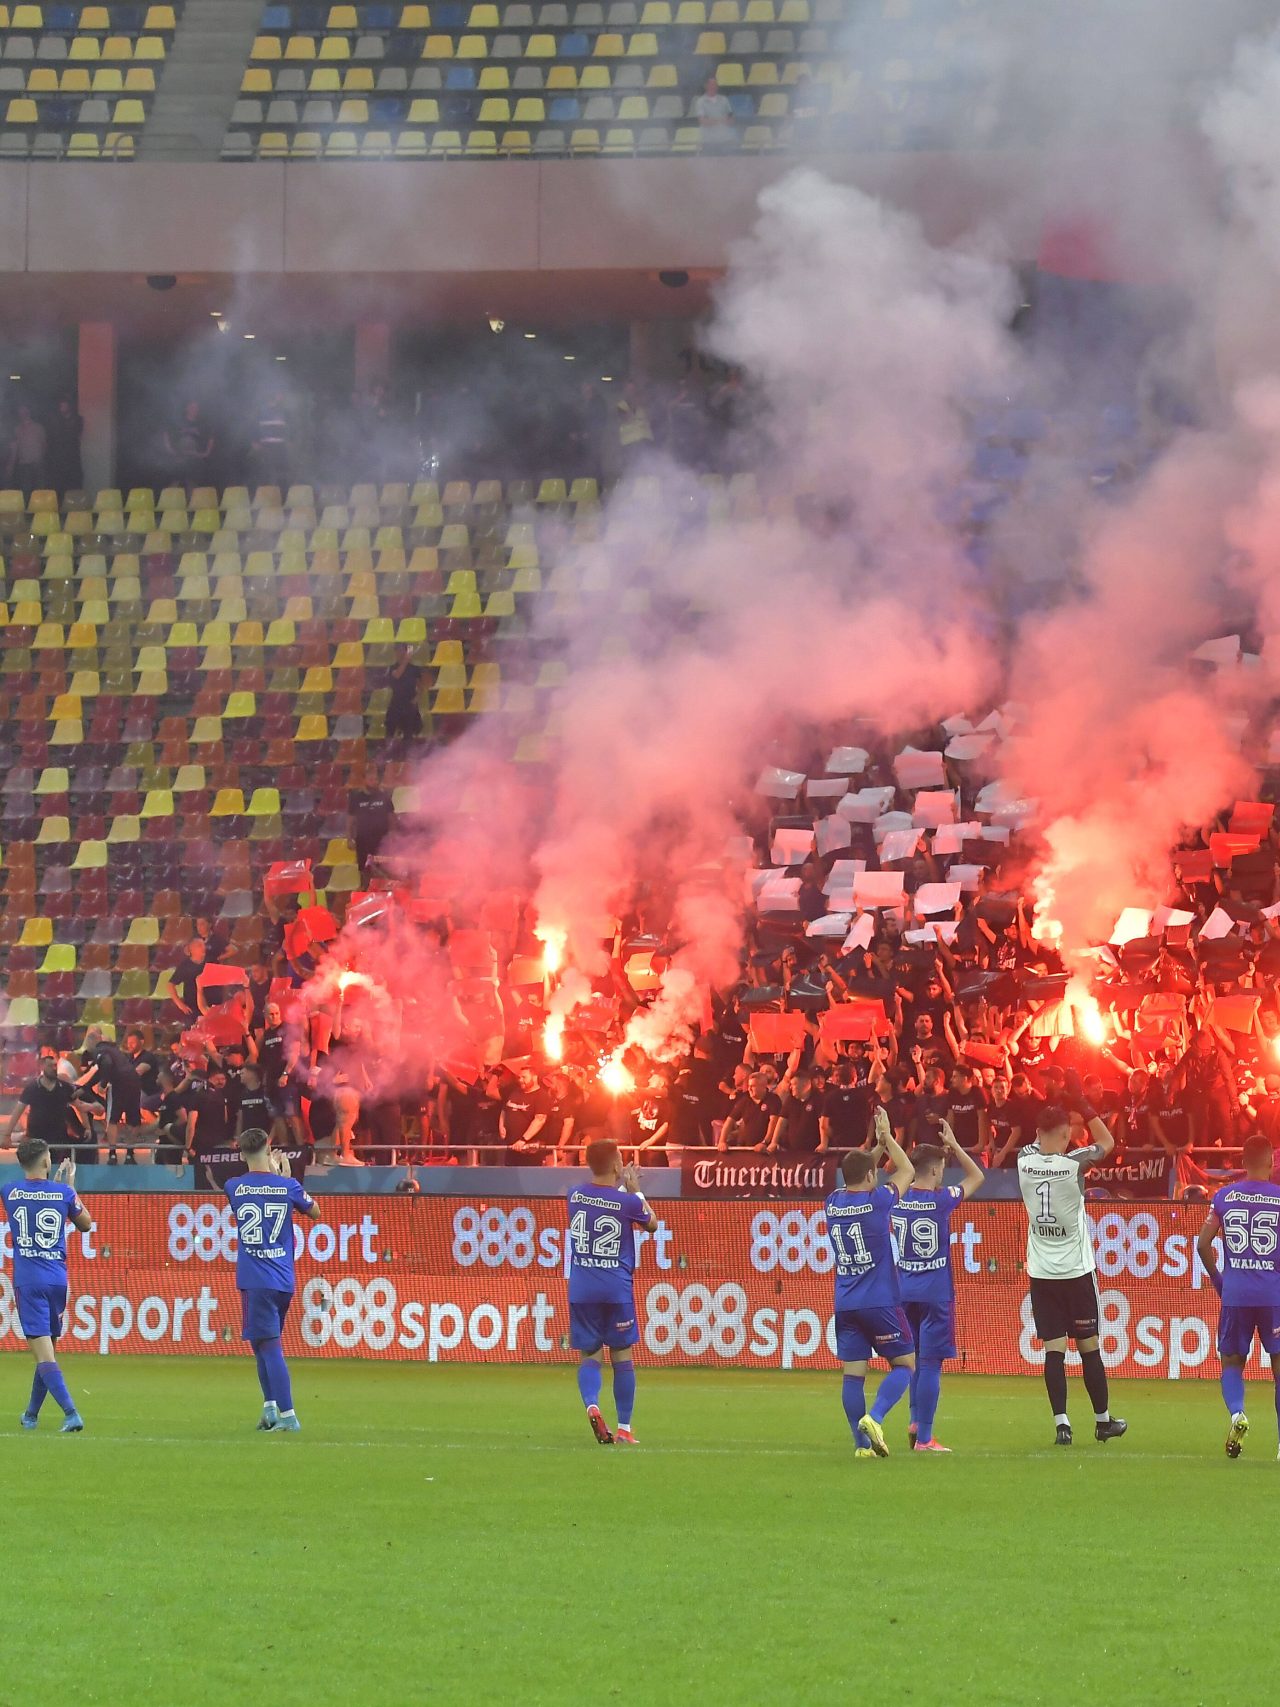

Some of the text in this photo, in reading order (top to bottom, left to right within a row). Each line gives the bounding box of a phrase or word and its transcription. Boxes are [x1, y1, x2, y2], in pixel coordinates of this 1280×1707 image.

[200, 1153, 241, 1164] MERE
[694, 1160, 825, 1188] Tineretului
[1028, 1167, 1070, 1177] Porotherm
[17, 1191, 63, 1200] Porotherm
[244, 1187, 288, 1195] Porotherm
[577, 1194, 621, 1210] Porotherm
[1035, 1181, 1057, 1223] 1
[1235, 1192, 1280, 1205] Porotherm
[13, 1206, 63, 1249] 19
[236, 1202, 288, 1245] 27
[831, 1205, 872, 1216] Porotherm
[570, 1210, 622, 1257] 42
[831, 1222, 873, 1265] 11
[891, 1215, 939, 1258] 79
[1222, 1208, 1280, 1256] 55
[301, 1277, 554, 1362] 888sport
